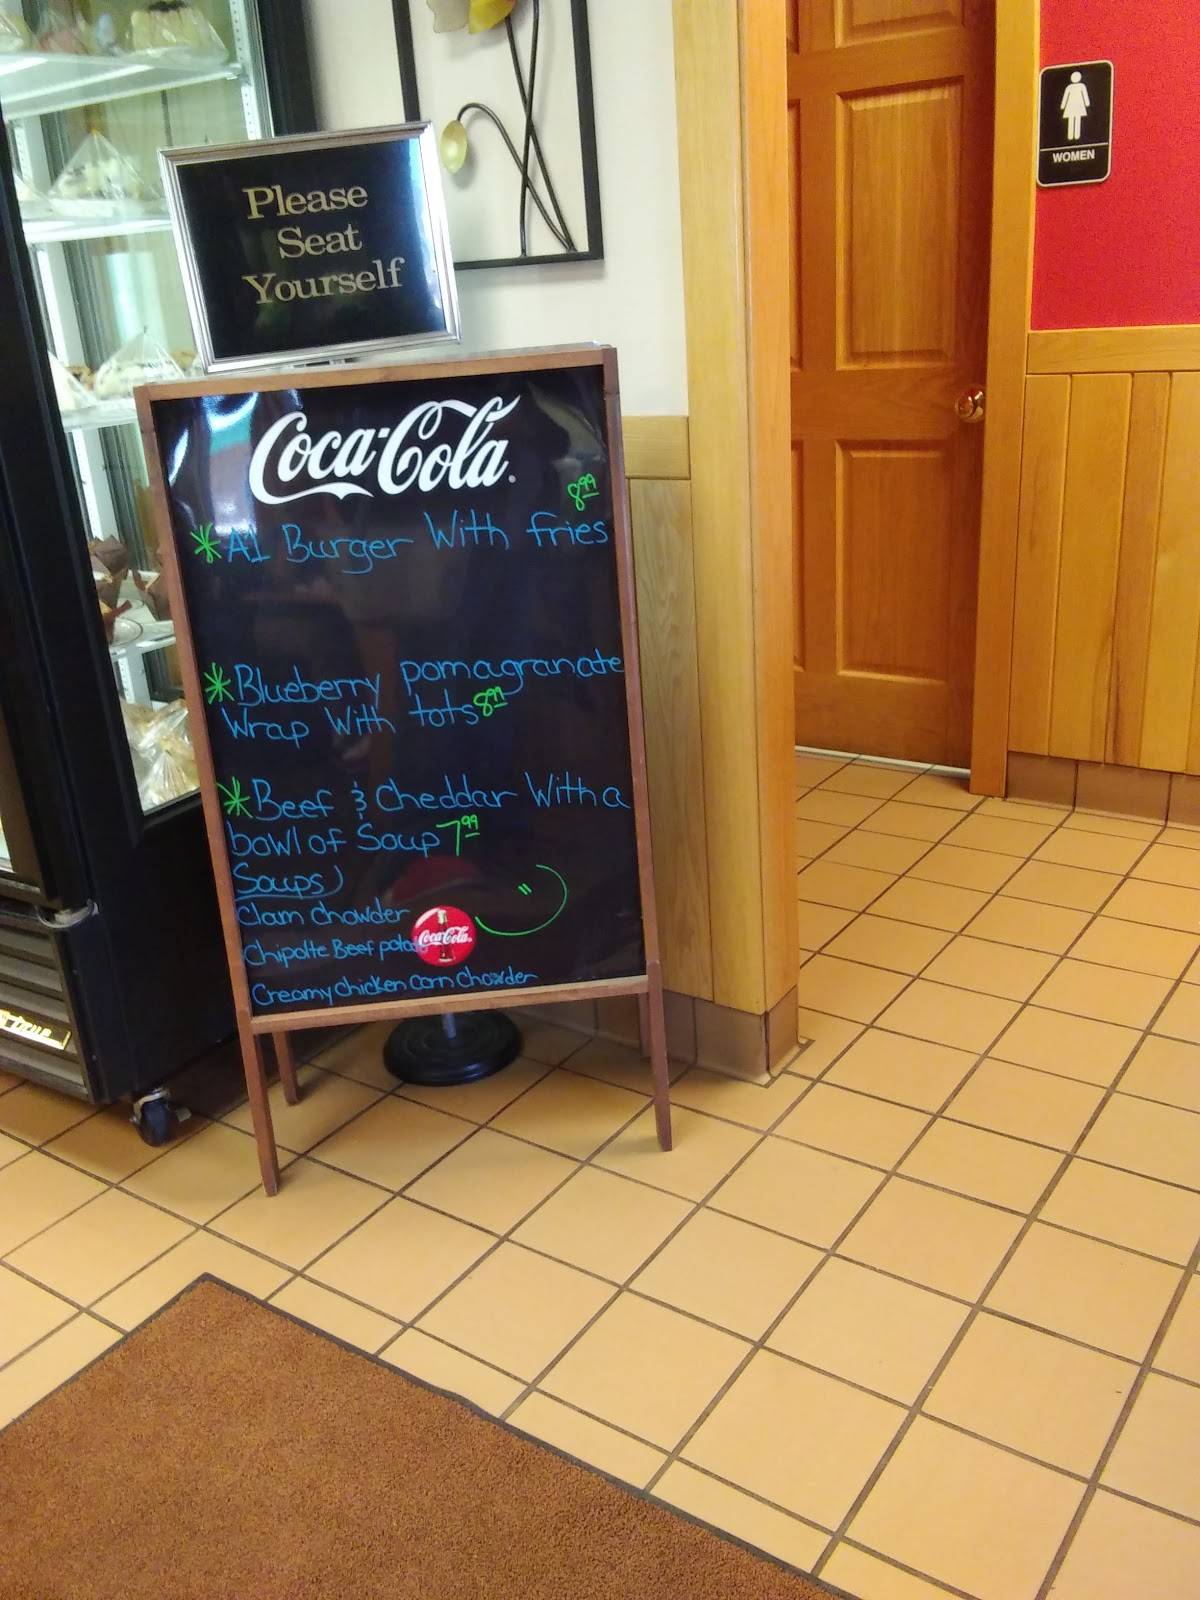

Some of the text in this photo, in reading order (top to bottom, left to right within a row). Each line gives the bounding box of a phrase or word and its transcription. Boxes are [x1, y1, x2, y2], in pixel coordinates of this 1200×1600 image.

[1053, 149, 1095, 163] WOMEN
[243, 184, 369, 219] Please
[277, 223, 363, 259] Seat
[243, 257, 405, 304] Yourself
[249, 395, 521, 504] Coca-Cola
[282, 523, 414, 574] Burger
[526, 511, 609, 547] fries
[234, 663, 381, 709] Blueberry
[221, 706, 309, 749] Wrap
[409, 688, 479, 727] tots
[252, 778, 335, 821] Beef
[376, 774, 517, 811] Cheddar
[602, 786, 631, 809] a
[227, 821, 301, 857] bowl
[308, 828, 347, 853] of
[357, 823, 440, 857] Soup
[237, 901, 305, 926] Clam
[331, 938, 374, 959] Beef
[252, 983, 333, 1006] Creamy
